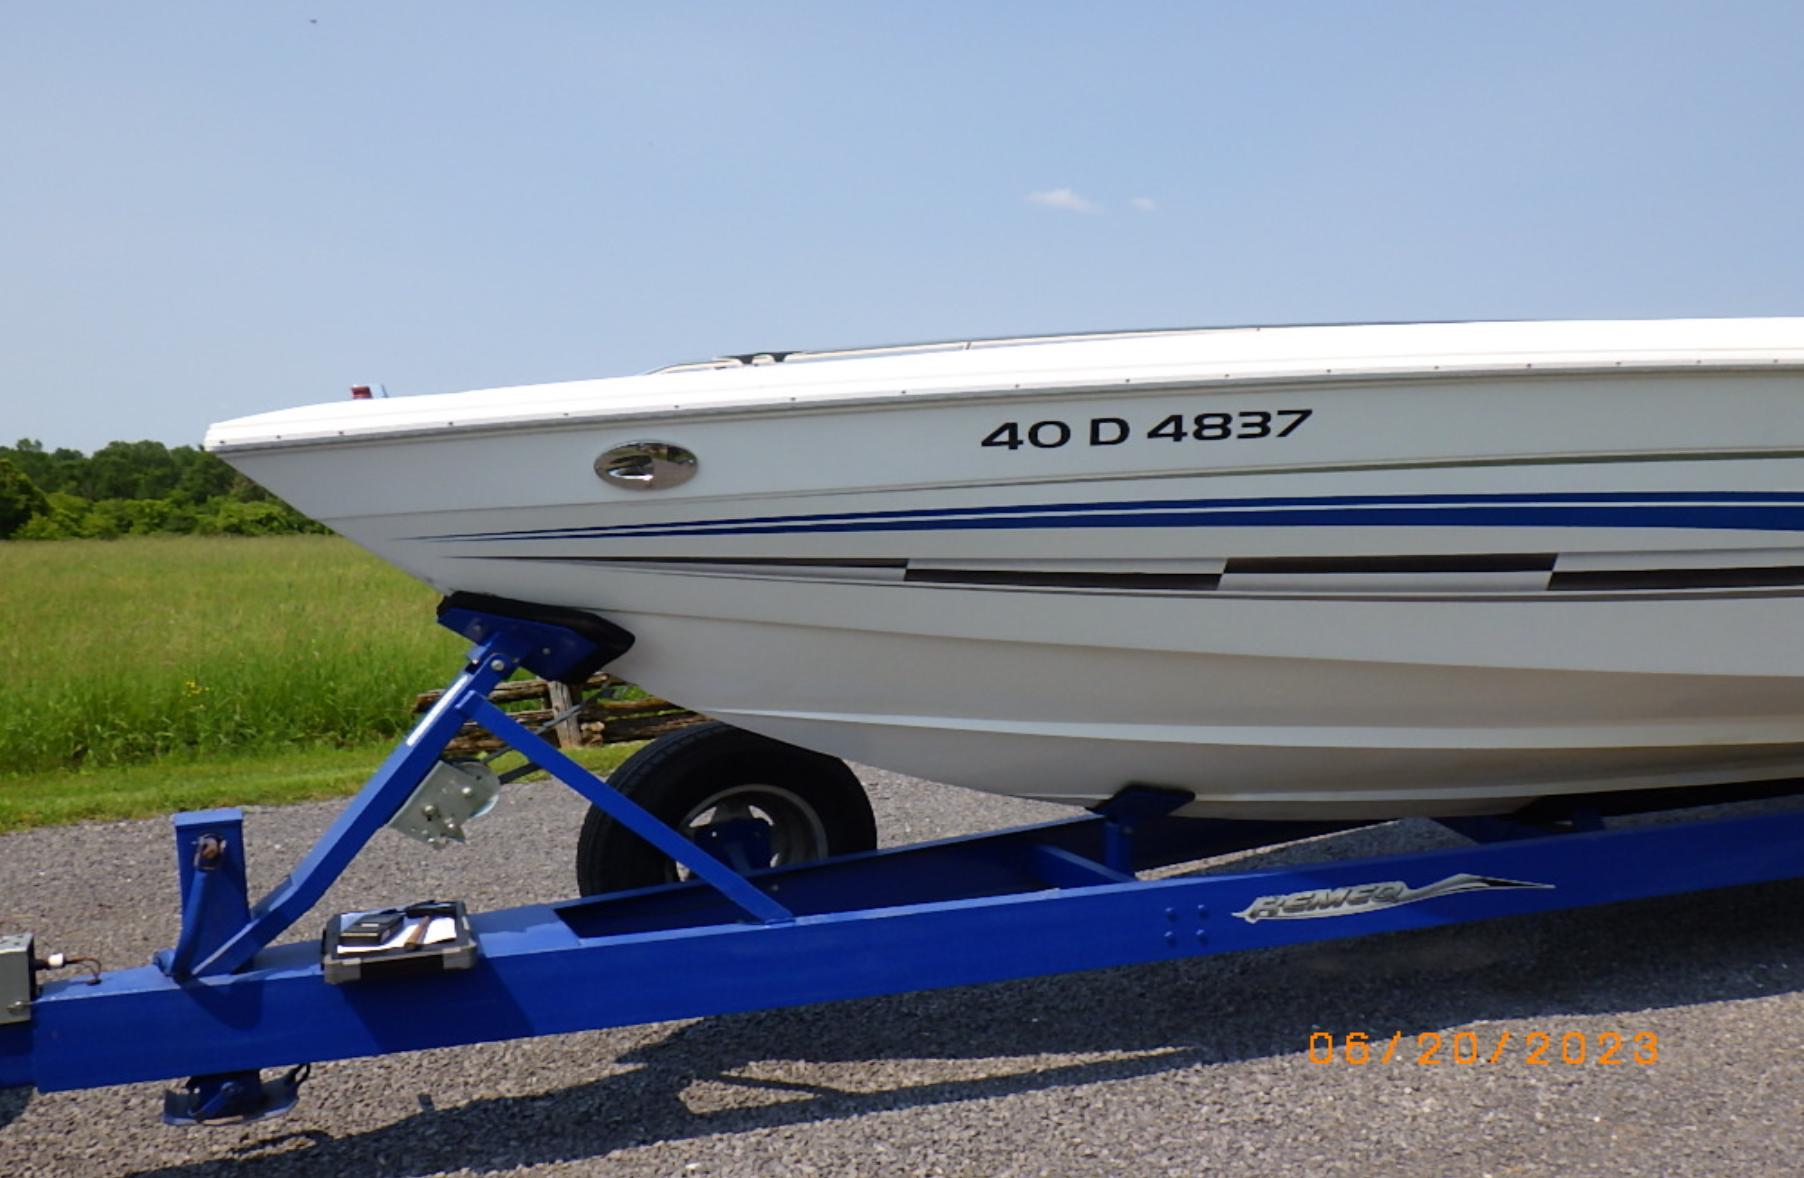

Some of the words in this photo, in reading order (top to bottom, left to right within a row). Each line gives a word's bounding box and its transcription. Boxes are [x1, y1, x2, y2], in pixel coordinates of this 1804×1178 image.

[980, 421, 1071, 450] 40
[1089, 417, 1130, 446] D
[1147, 409, 1313, 442] 4837
